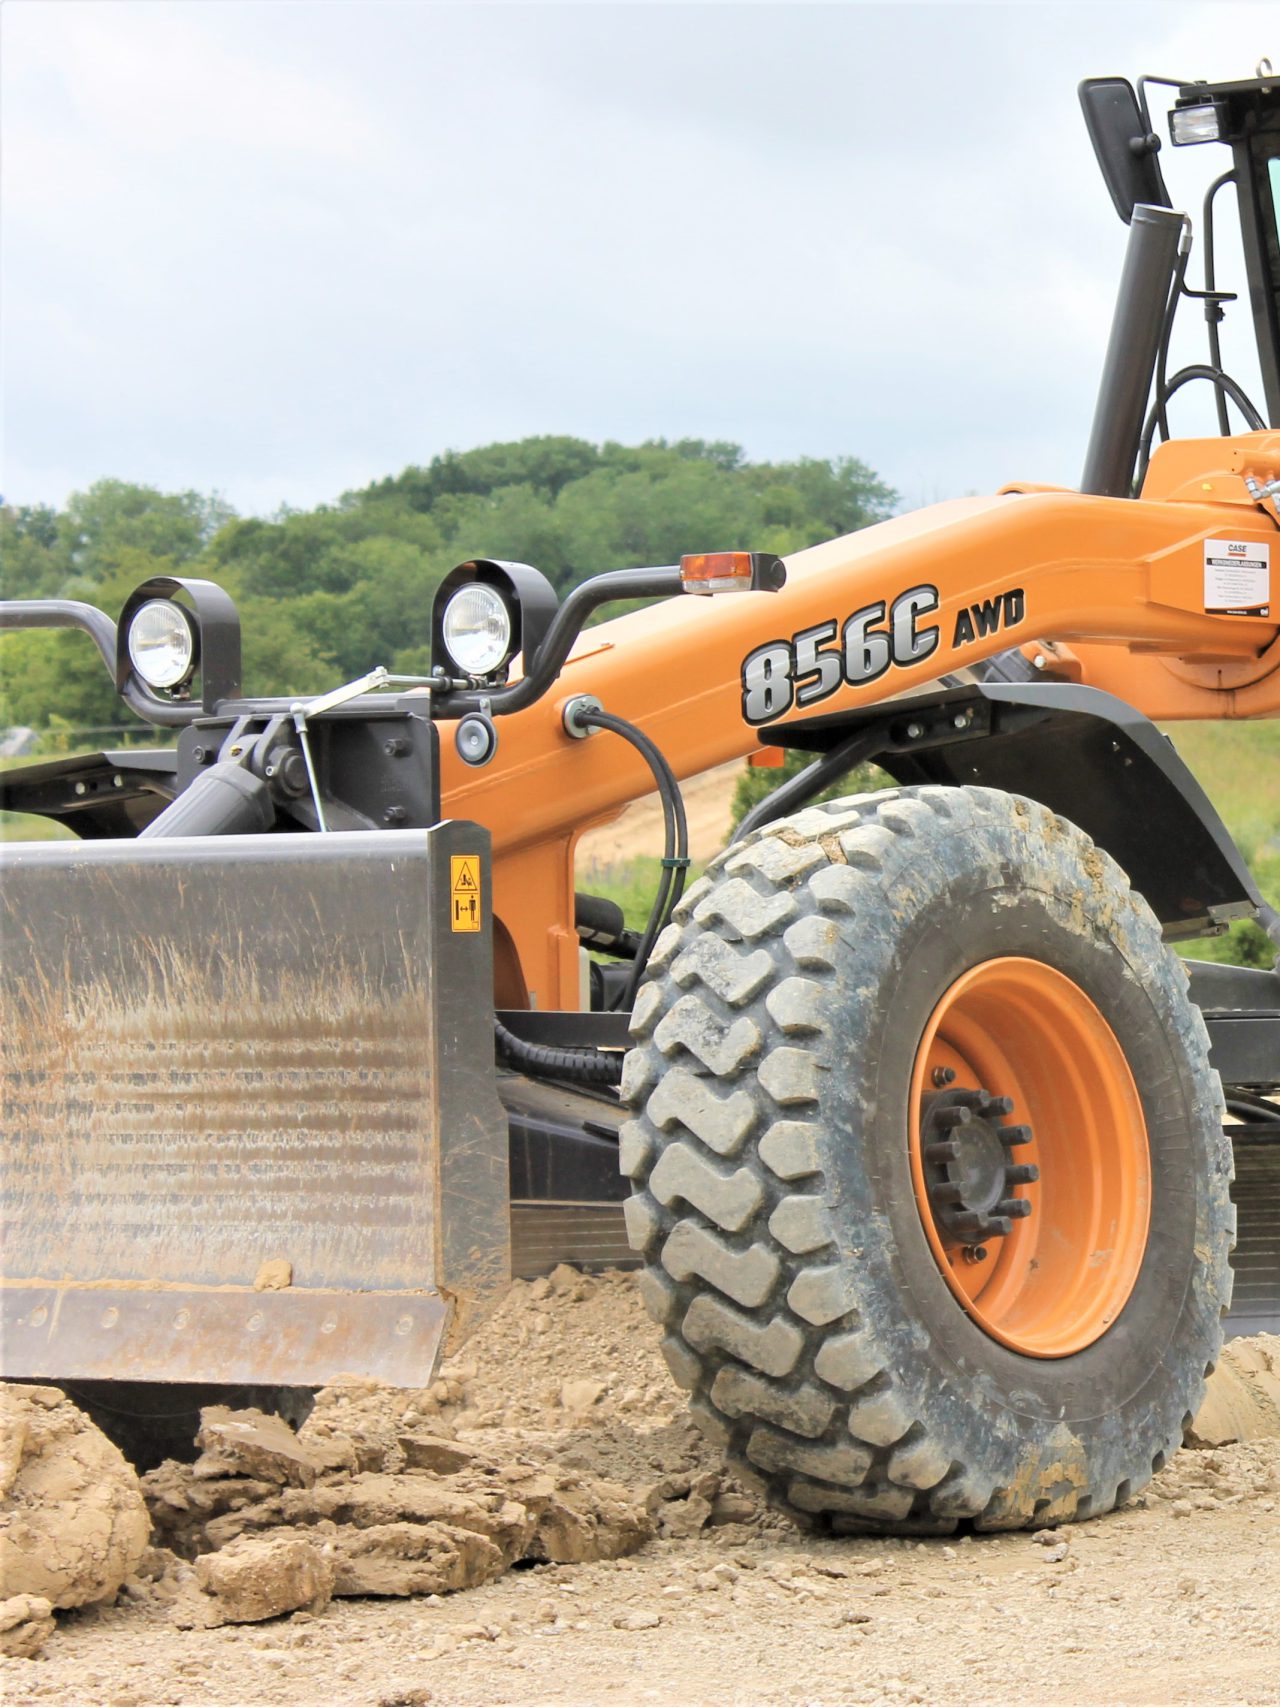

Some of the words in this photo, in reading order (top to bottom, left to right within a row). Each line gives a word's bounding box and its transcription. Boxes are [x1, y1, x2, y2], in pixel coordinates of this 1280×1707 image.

[1228, 544, 1247, 553] CASE
[741, 584, 939, 725] 856C
[952, 588, 1024, 649] AWD
